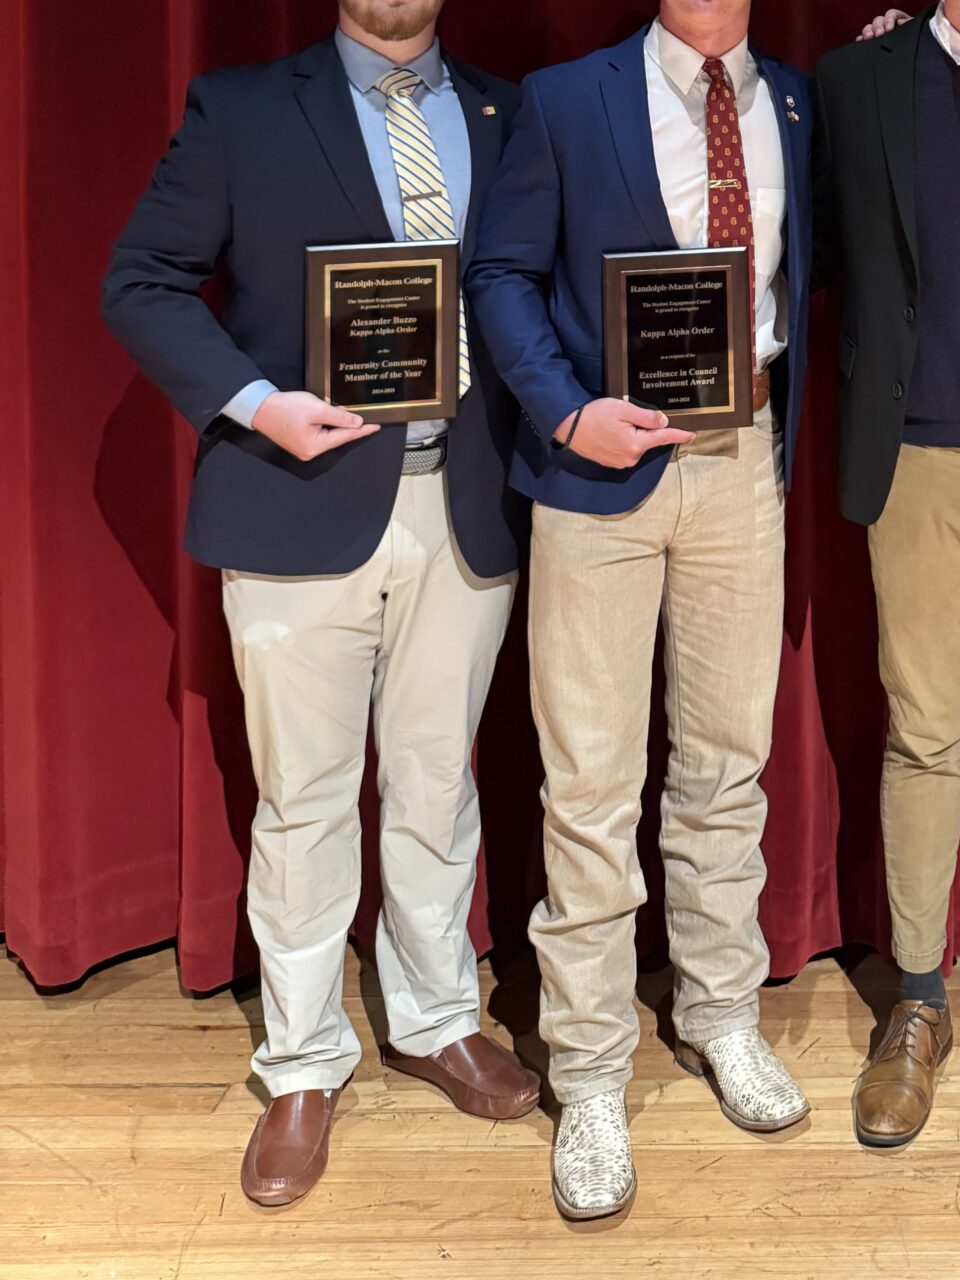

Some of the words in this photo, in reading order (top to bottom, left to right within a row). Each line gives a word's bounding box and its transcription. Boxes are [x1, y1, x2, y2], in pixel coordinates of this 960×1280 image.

[335, 279, 402, 288] Randolph-Macon
[630, 284, 694, 293] Randolph-Macon
[350, 318, 391, 327] Alexander
[350, 329, 373, 337] Kappa
[641, 330, 665, 339] Kappa
[667, 328, 690, 337] Alpha
[339, 361, 380, 371] Fraternity
[382, 358, 427, 367] Community
[345, 373, 377, 382] Member
[640, 371, 679, 379] Excellence
[688, 367, 718, 375] Council
[643, 381, 688, 389] Involvement
